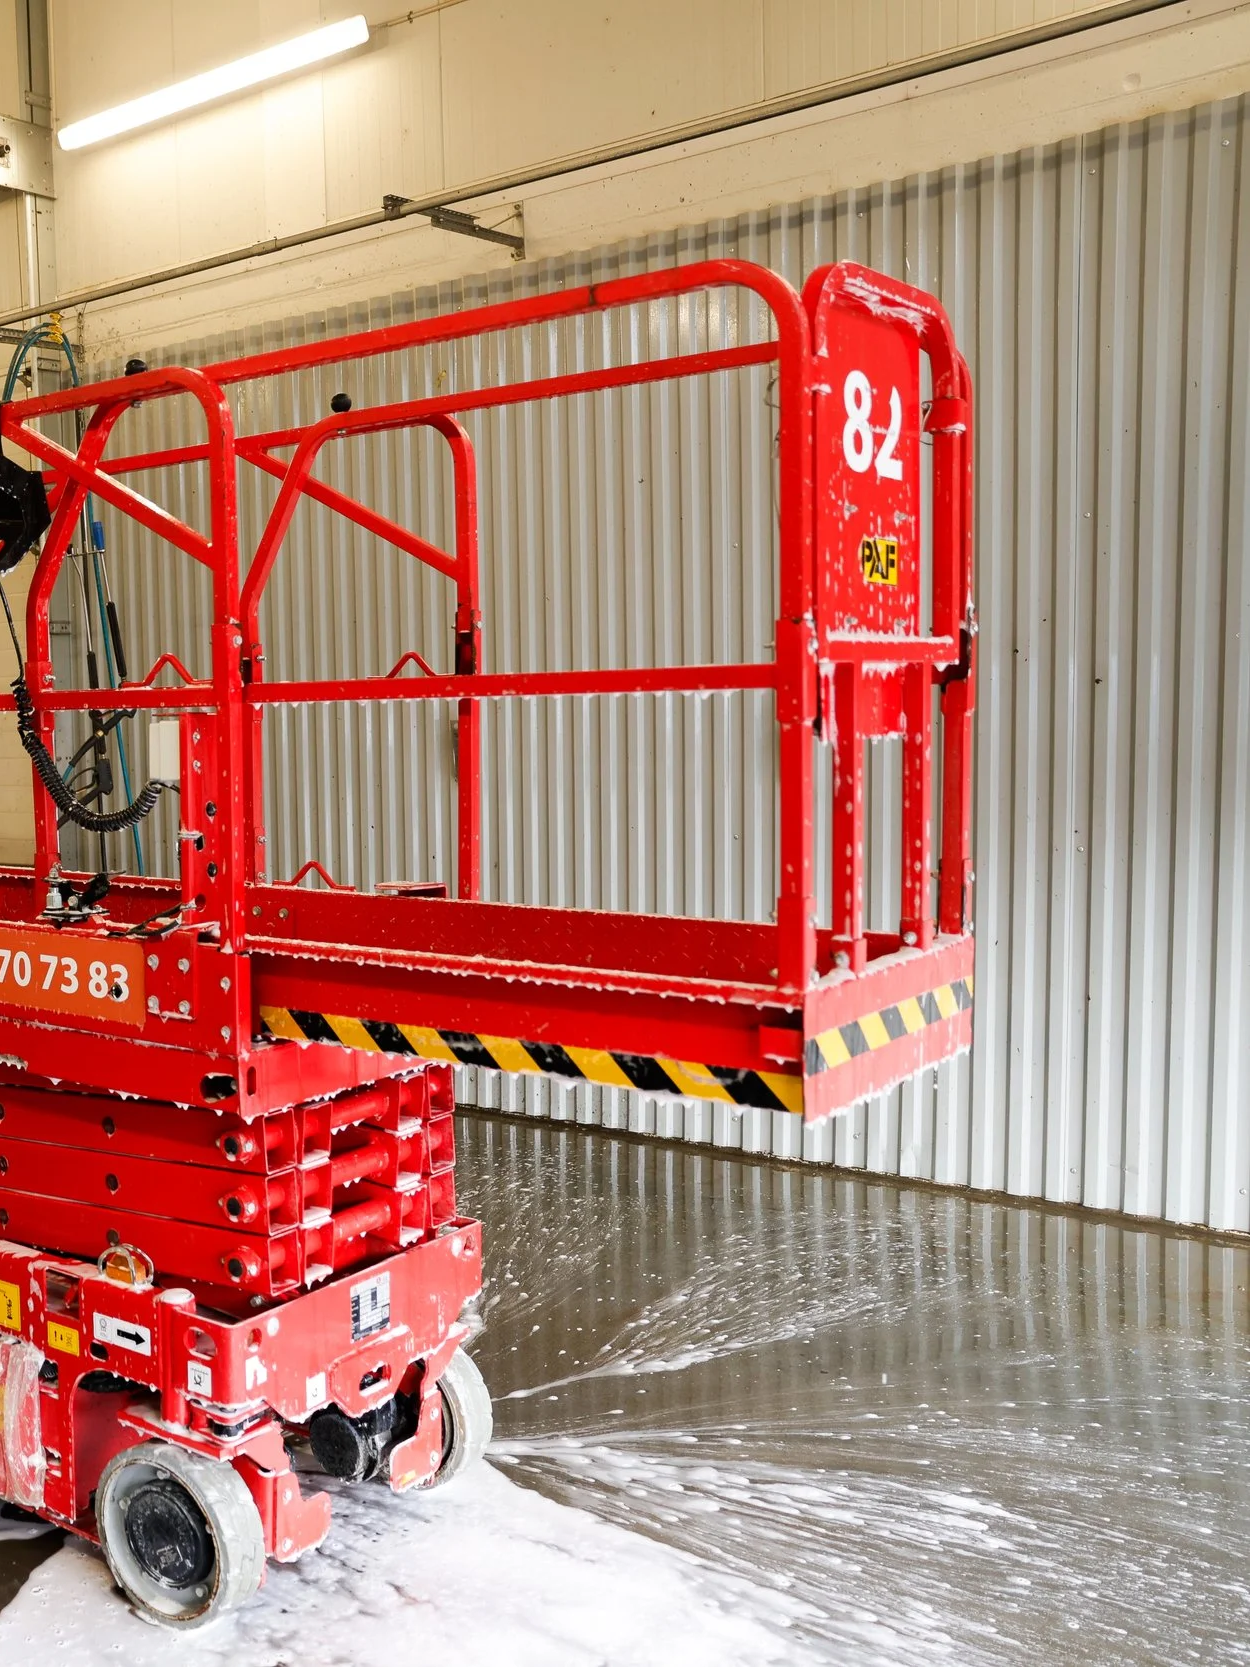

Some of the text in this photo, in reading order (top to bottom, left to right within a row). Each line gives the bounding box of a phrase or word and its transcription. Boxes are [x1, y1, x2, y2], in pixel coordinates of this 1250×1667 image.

[843, 369, 903, 481] 82
[39, 954, 79, 994] 73
[88, 961, 130, 1003] 83
